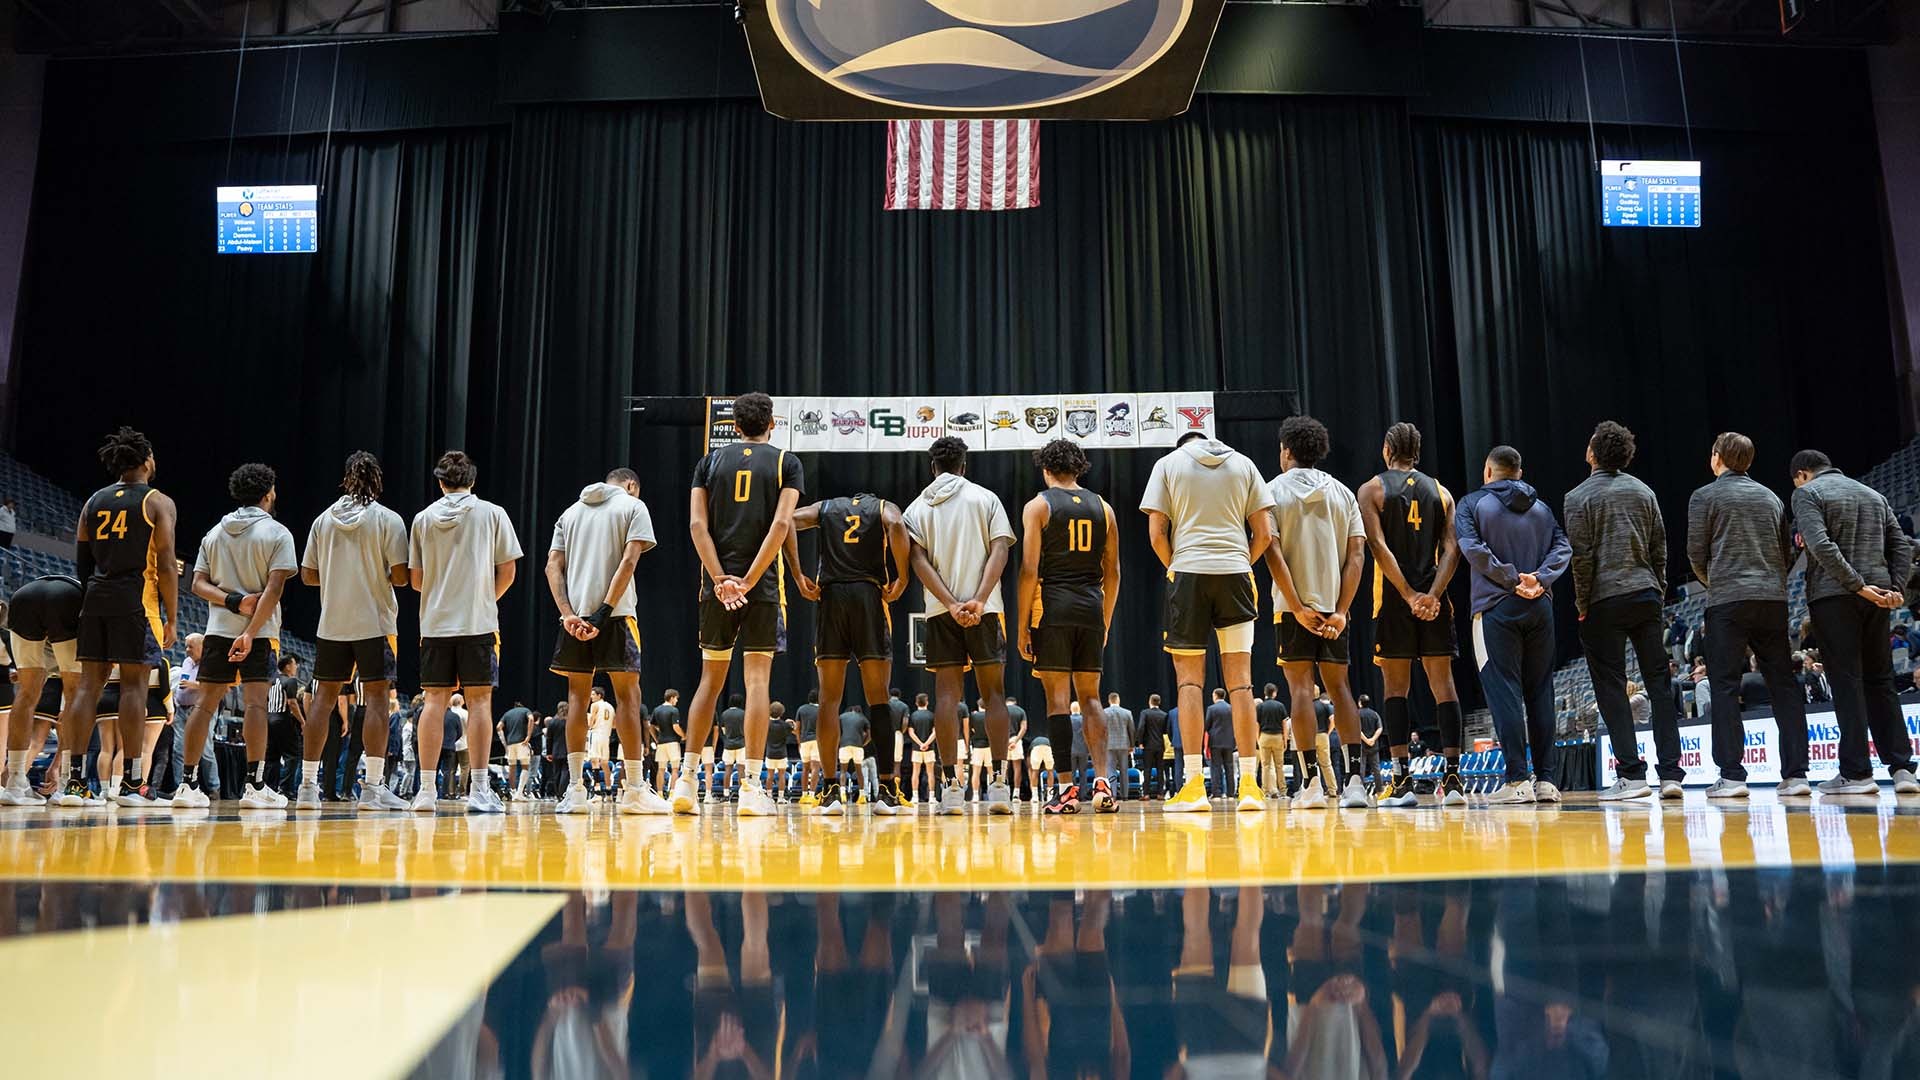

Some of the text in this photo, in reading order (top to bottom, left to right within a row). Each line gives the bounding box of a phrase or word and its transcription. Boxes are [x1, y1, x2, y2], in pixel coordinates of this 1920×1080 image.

[907, 426, 943, 438] IUPUI
[1176, 407, 1213, 429] Y
[734, 470, 752, 502] 0
[96, 510, 128, 540] 24
[843, 515, 861, 544] 2
[1407, 500, 1422, 531] 4
[1068, 519, 1092, 552] 10
